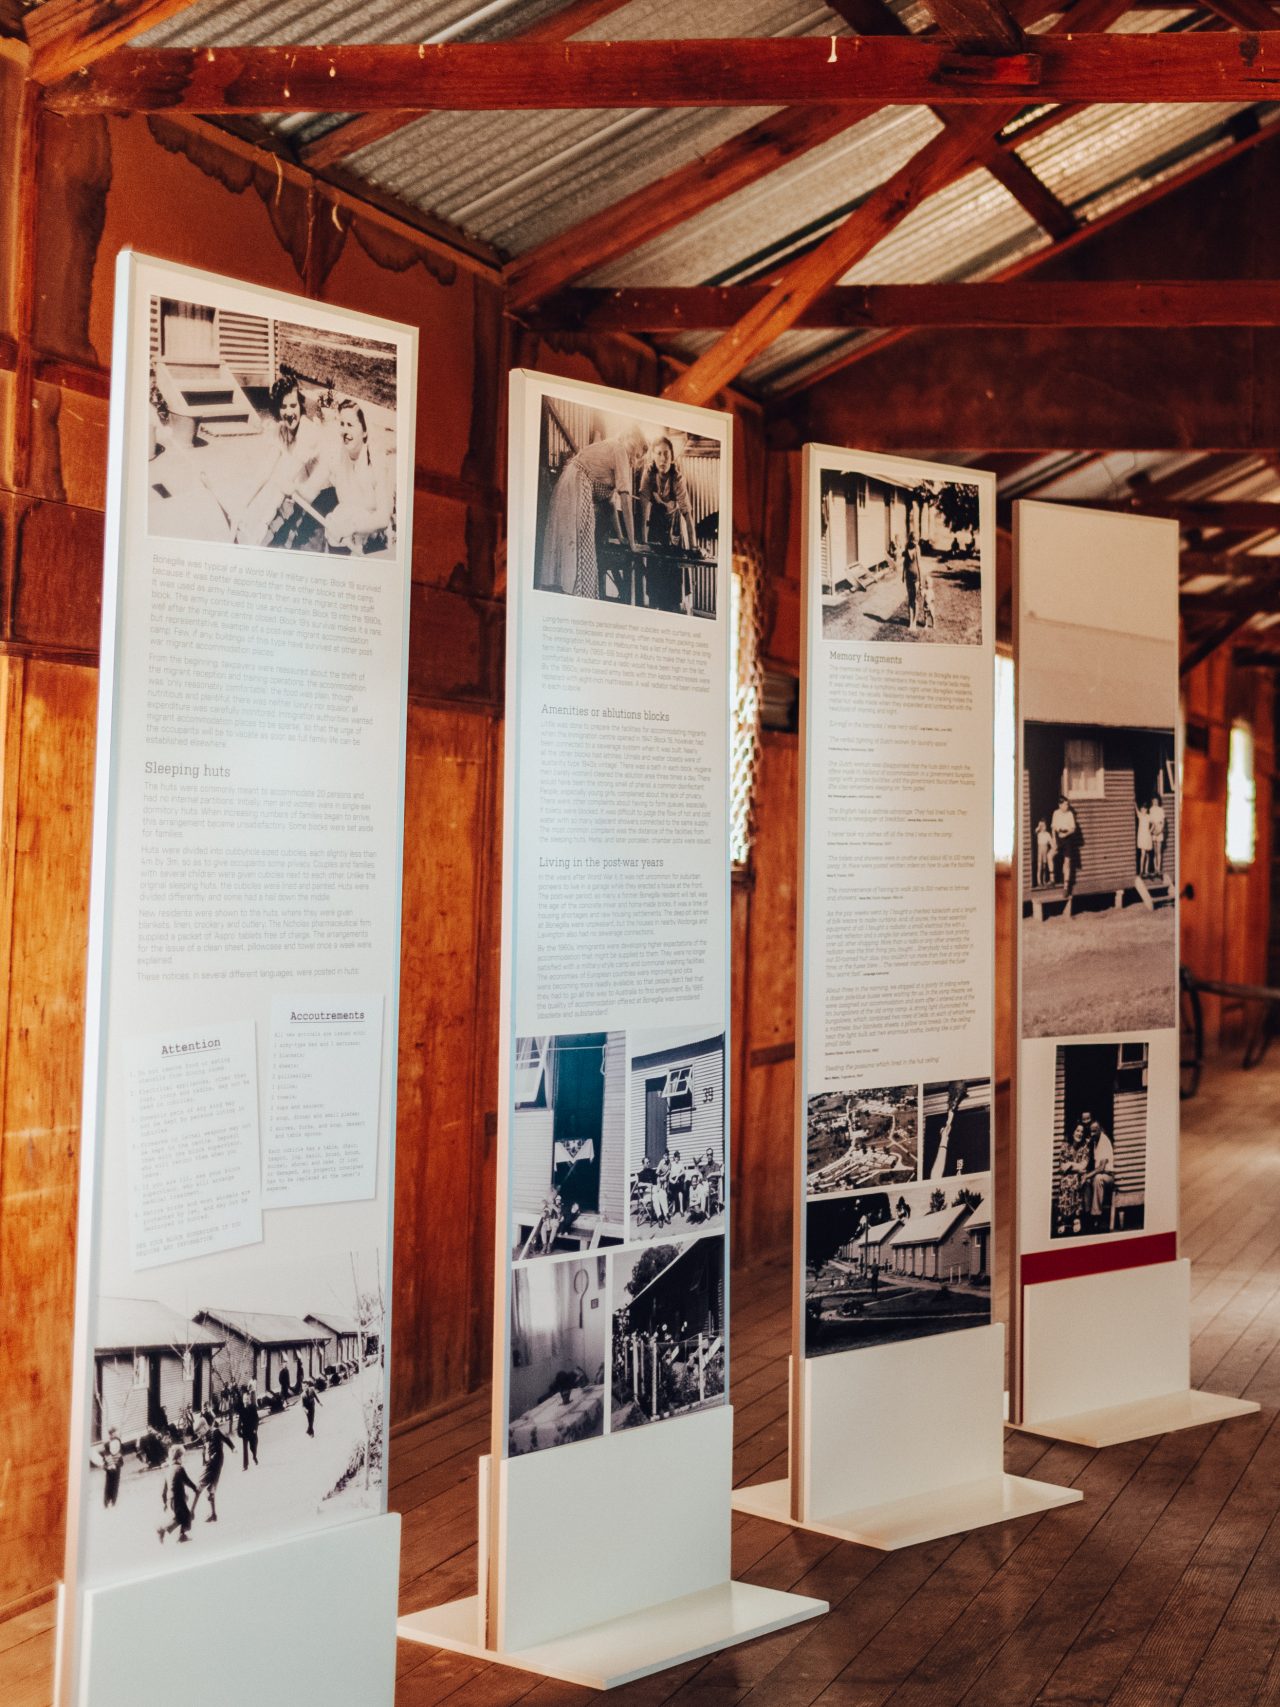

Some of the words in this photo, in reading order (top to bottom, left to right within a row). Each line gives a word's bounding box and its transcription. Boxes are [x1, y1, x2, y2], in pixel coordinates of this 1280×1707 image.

[829, 650, 861, 663] Memory
[864, 652, 903, 664] fragments
[541, 704, 589, 716] Amenities
[591, 708, 600, 717] or
[602, 708, 642, 720] ablutions
[644, 710, 670, 721] blocks
[145, 761, 200, 779] Sleeping
[203, 763, 231, 777] huts
[539, 856, 570, 869] Living
[573, 857, 583, 867] in
[585, 856, 601, 867] the
[603, 857, 639, 869] post-war
[641, 859, 664, 869] years
[290, 1011, 365, 1021] Accoutrements
[161, 1038, 221, 1055] Attention
